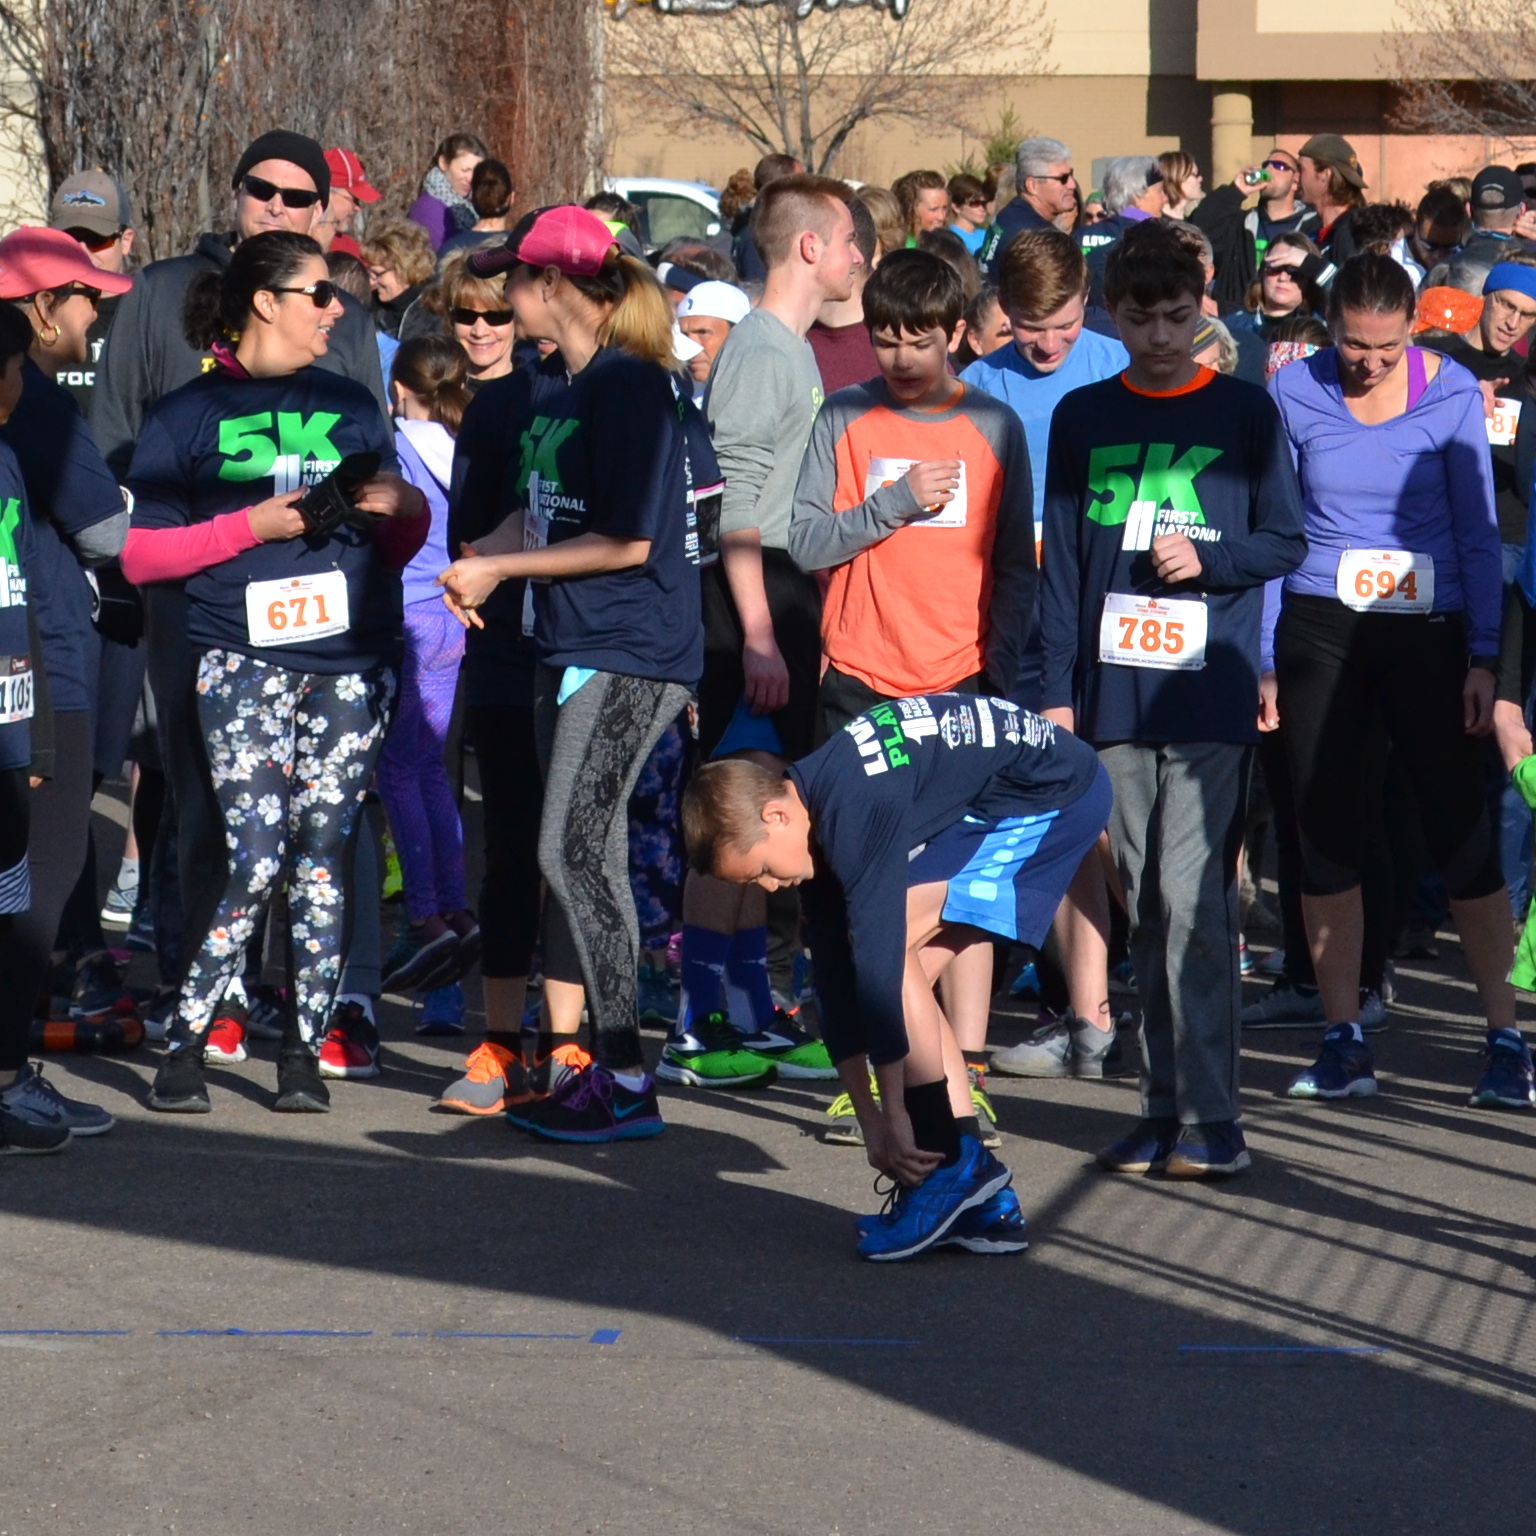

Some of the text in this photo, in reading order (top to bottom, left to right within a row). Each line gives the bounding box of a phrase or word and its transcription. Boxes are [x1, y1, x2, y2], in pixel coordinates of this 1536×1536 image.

[1081, 234, 1116, 247] LIV
[218, 411, 343, 482] 5K
[1086, 443, 1224, 526] 5K
[1156, 508, 1200, 525] FIRST
[1354, 568, 1418, 601] 694
[267, 594, 330, 631] 671
[1118, 616, 1185, 655] 785
